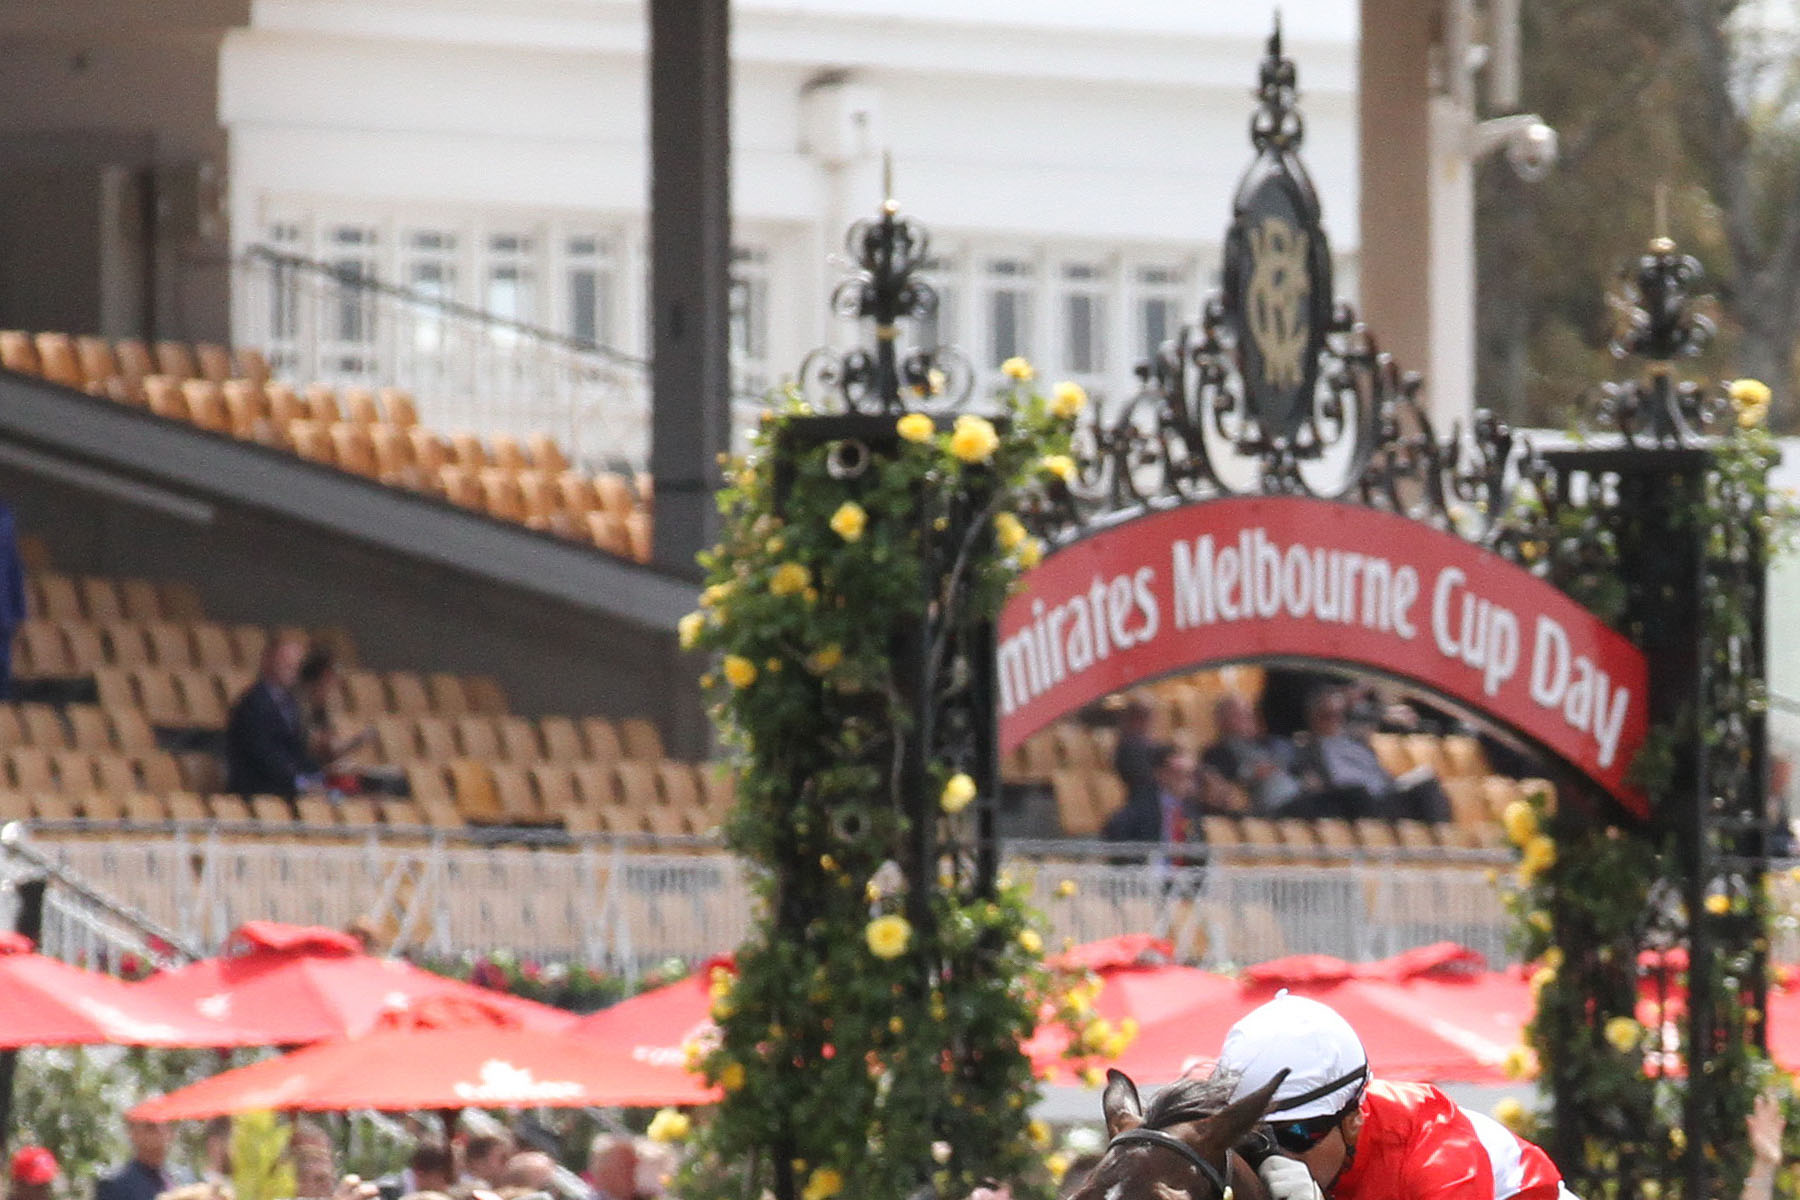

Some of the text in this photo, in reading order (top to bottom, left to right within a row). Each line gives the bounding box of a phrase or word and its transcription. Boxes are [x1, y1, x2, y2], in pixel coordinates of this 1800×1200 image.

[997, 528, 1630, 768] mirates Melbourne Cup Day
